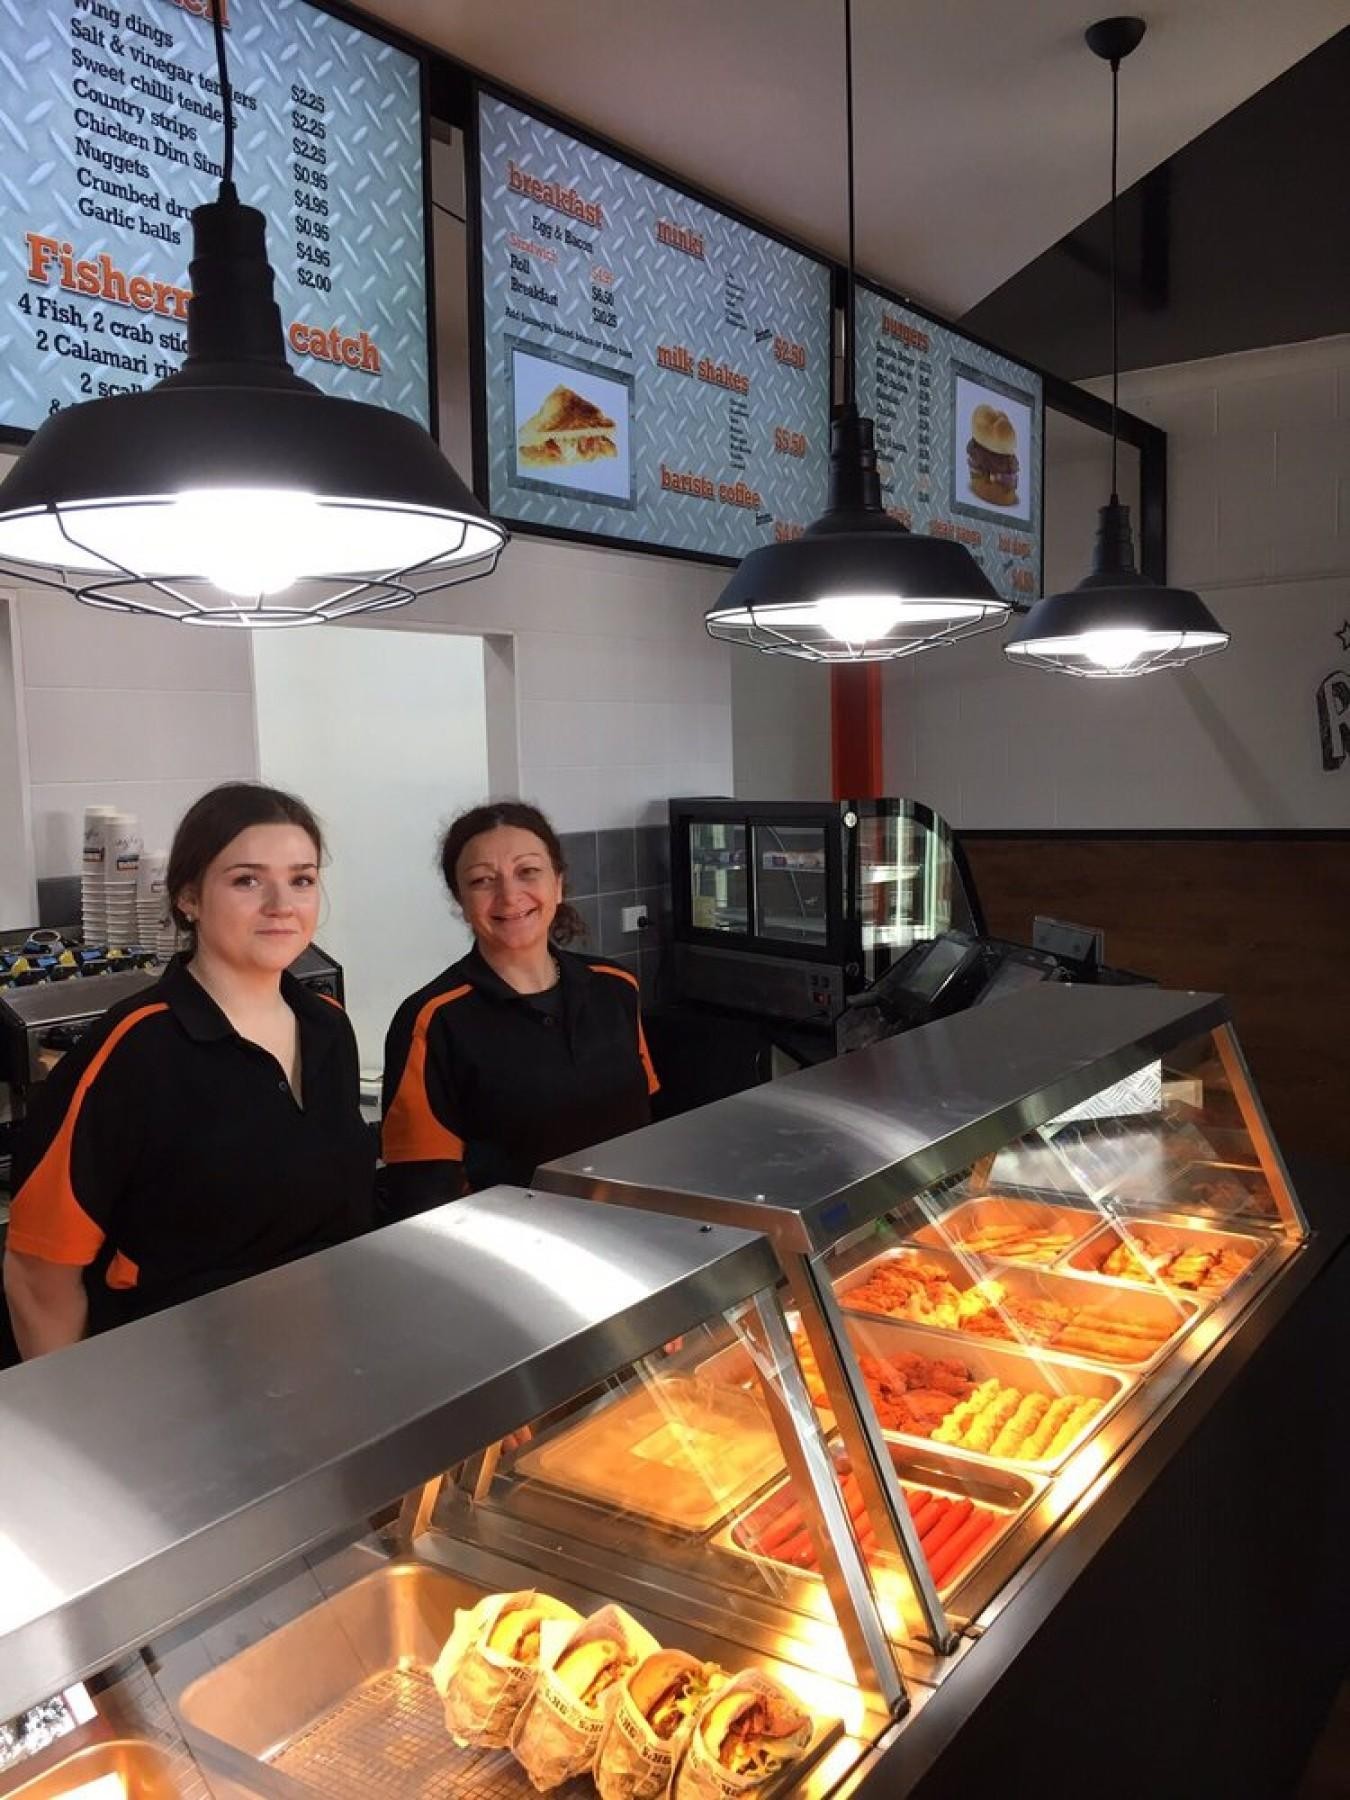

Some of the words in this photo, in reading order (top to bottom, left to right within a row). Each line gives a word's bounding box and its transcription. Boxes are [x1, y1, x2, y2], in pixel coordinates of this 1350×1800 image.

[126, 14, 174, 48] dings
[71, 18, 105, 48] Salt
[110, 34, 124, 56] &
[129, 46, 195, 85] vinegar
[199, 73, 258, 111] teners
[71, 48, 125, 85] Sweet
[130, 75, 174, 104] chilli
[178, 91, 238, 129] tendes
[72, 78, 145, 124] Country
[151, 112, 197, 141] strips
[291, 85, 325, 114] $2.25
[74, 108, 150, 152] Chicken
[153, 136, 189, 167] Dim
[291, 111, 327, 140] $2.25
[75, 136, 150, 179] Nuggets
[293, 137, 327, 165] $2.25
[77, 167, 160, 212] Crumbed
[294, 163, 328, 191] $0.95
[506, 160, 604, 231] breakfast
[78, 198, 136, 230] Garlic
[139, 215, 181, 245] balls
[295, 189, 328, 217] $4.95
[295, 215, 330, 242] $0.95
[297, 241, 331, 267] $4.95
[510, 253, 530, 274] Roll
[297, 267, 332, 292] $2.00
[510, 276, 558, 307] Breakfast
[18, 293, 32, 316] 4
[37, 296, 88, 333] Fish,
[93, 312, 105, 333] 2
[110, 320, 153, 345] crab
[36, 329, 49, 351] 2
[54, 335, 148, 375] Calamari
[288, 320, 382, 375] catch
[80, 372, 92, 394] 2
[656, 344, 694, 379] milk
[697, 357, 749, 396] shakes
[660, 462, 716, 502] barista
[718, 479, 762, 511] coffee
